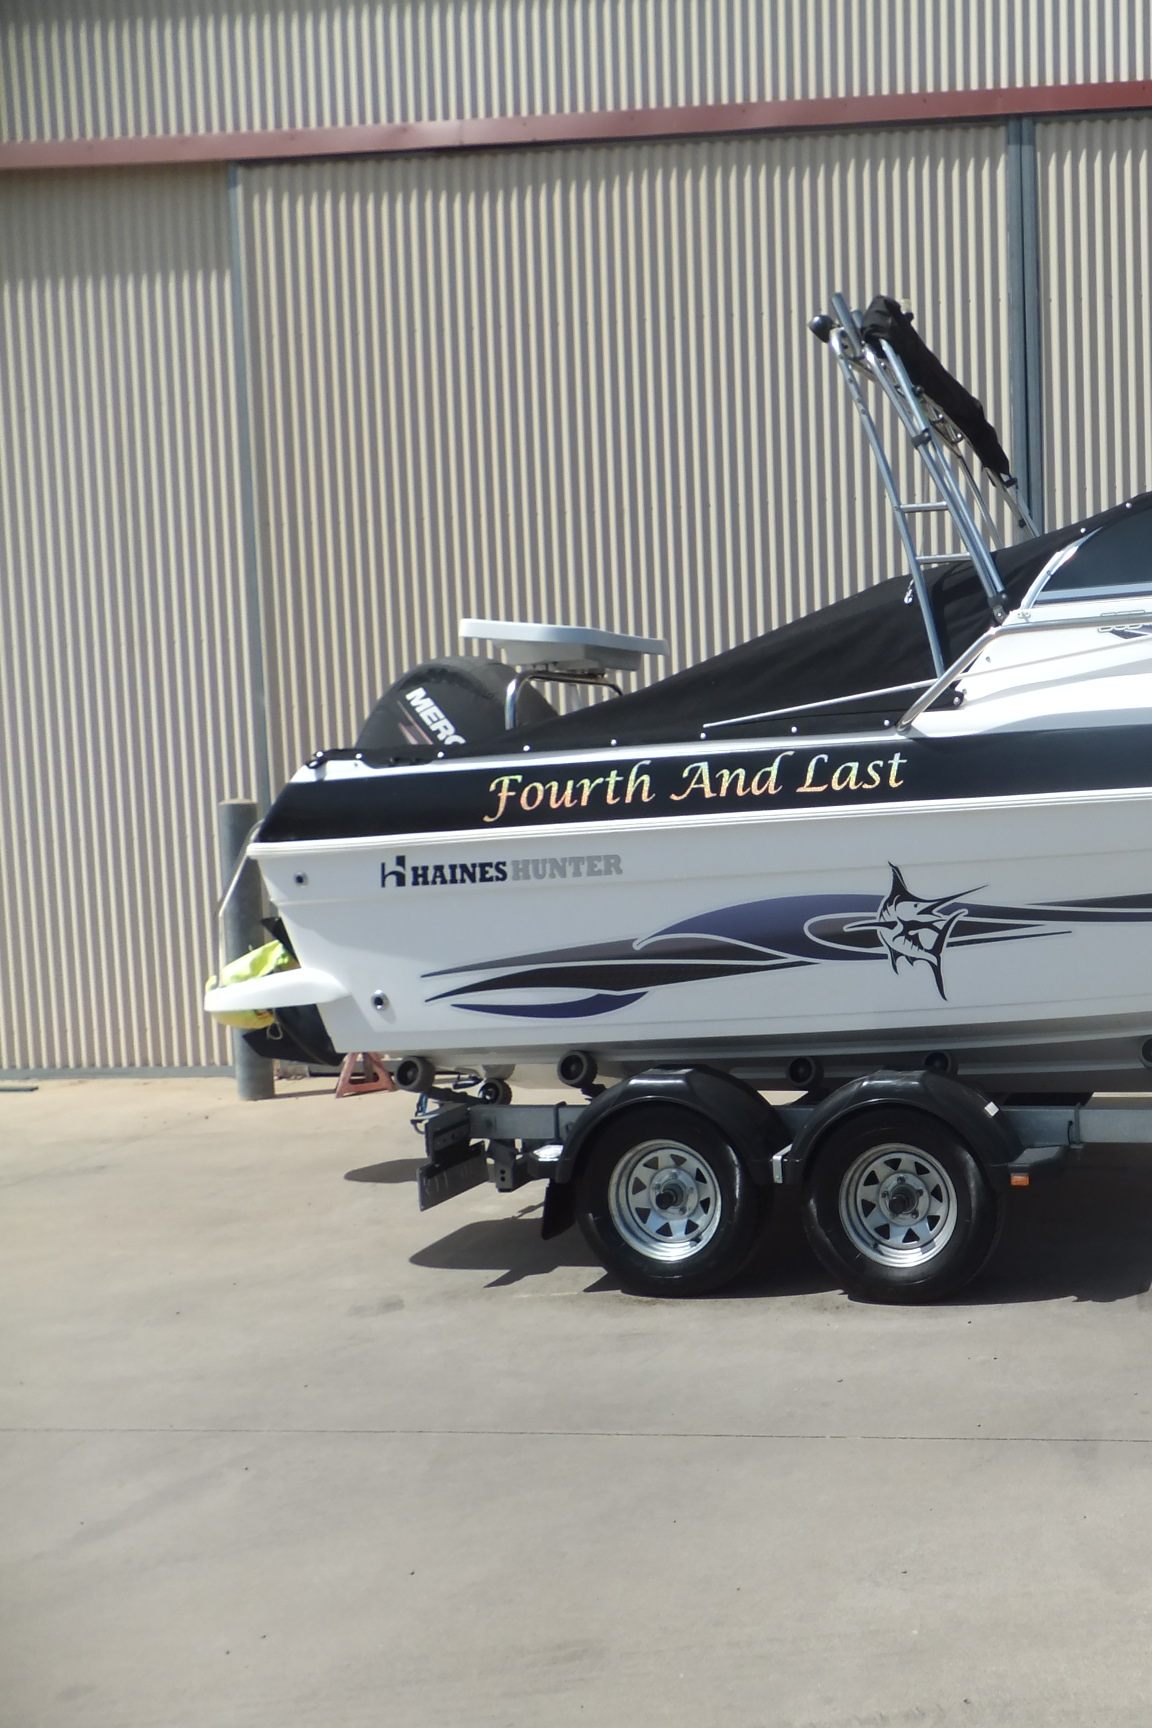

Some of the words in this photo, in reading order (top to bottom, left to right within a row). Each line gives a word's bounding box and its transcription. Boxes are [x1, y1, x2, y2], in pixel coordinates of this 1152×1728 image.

[482, 759, 656, 822] Fourth
[669, 751, 795, 801] And
[795, 752, 908, 793] Last
[411, 861, 508, 887] HAINES
[511, 854, 623, 881] HUNTER
